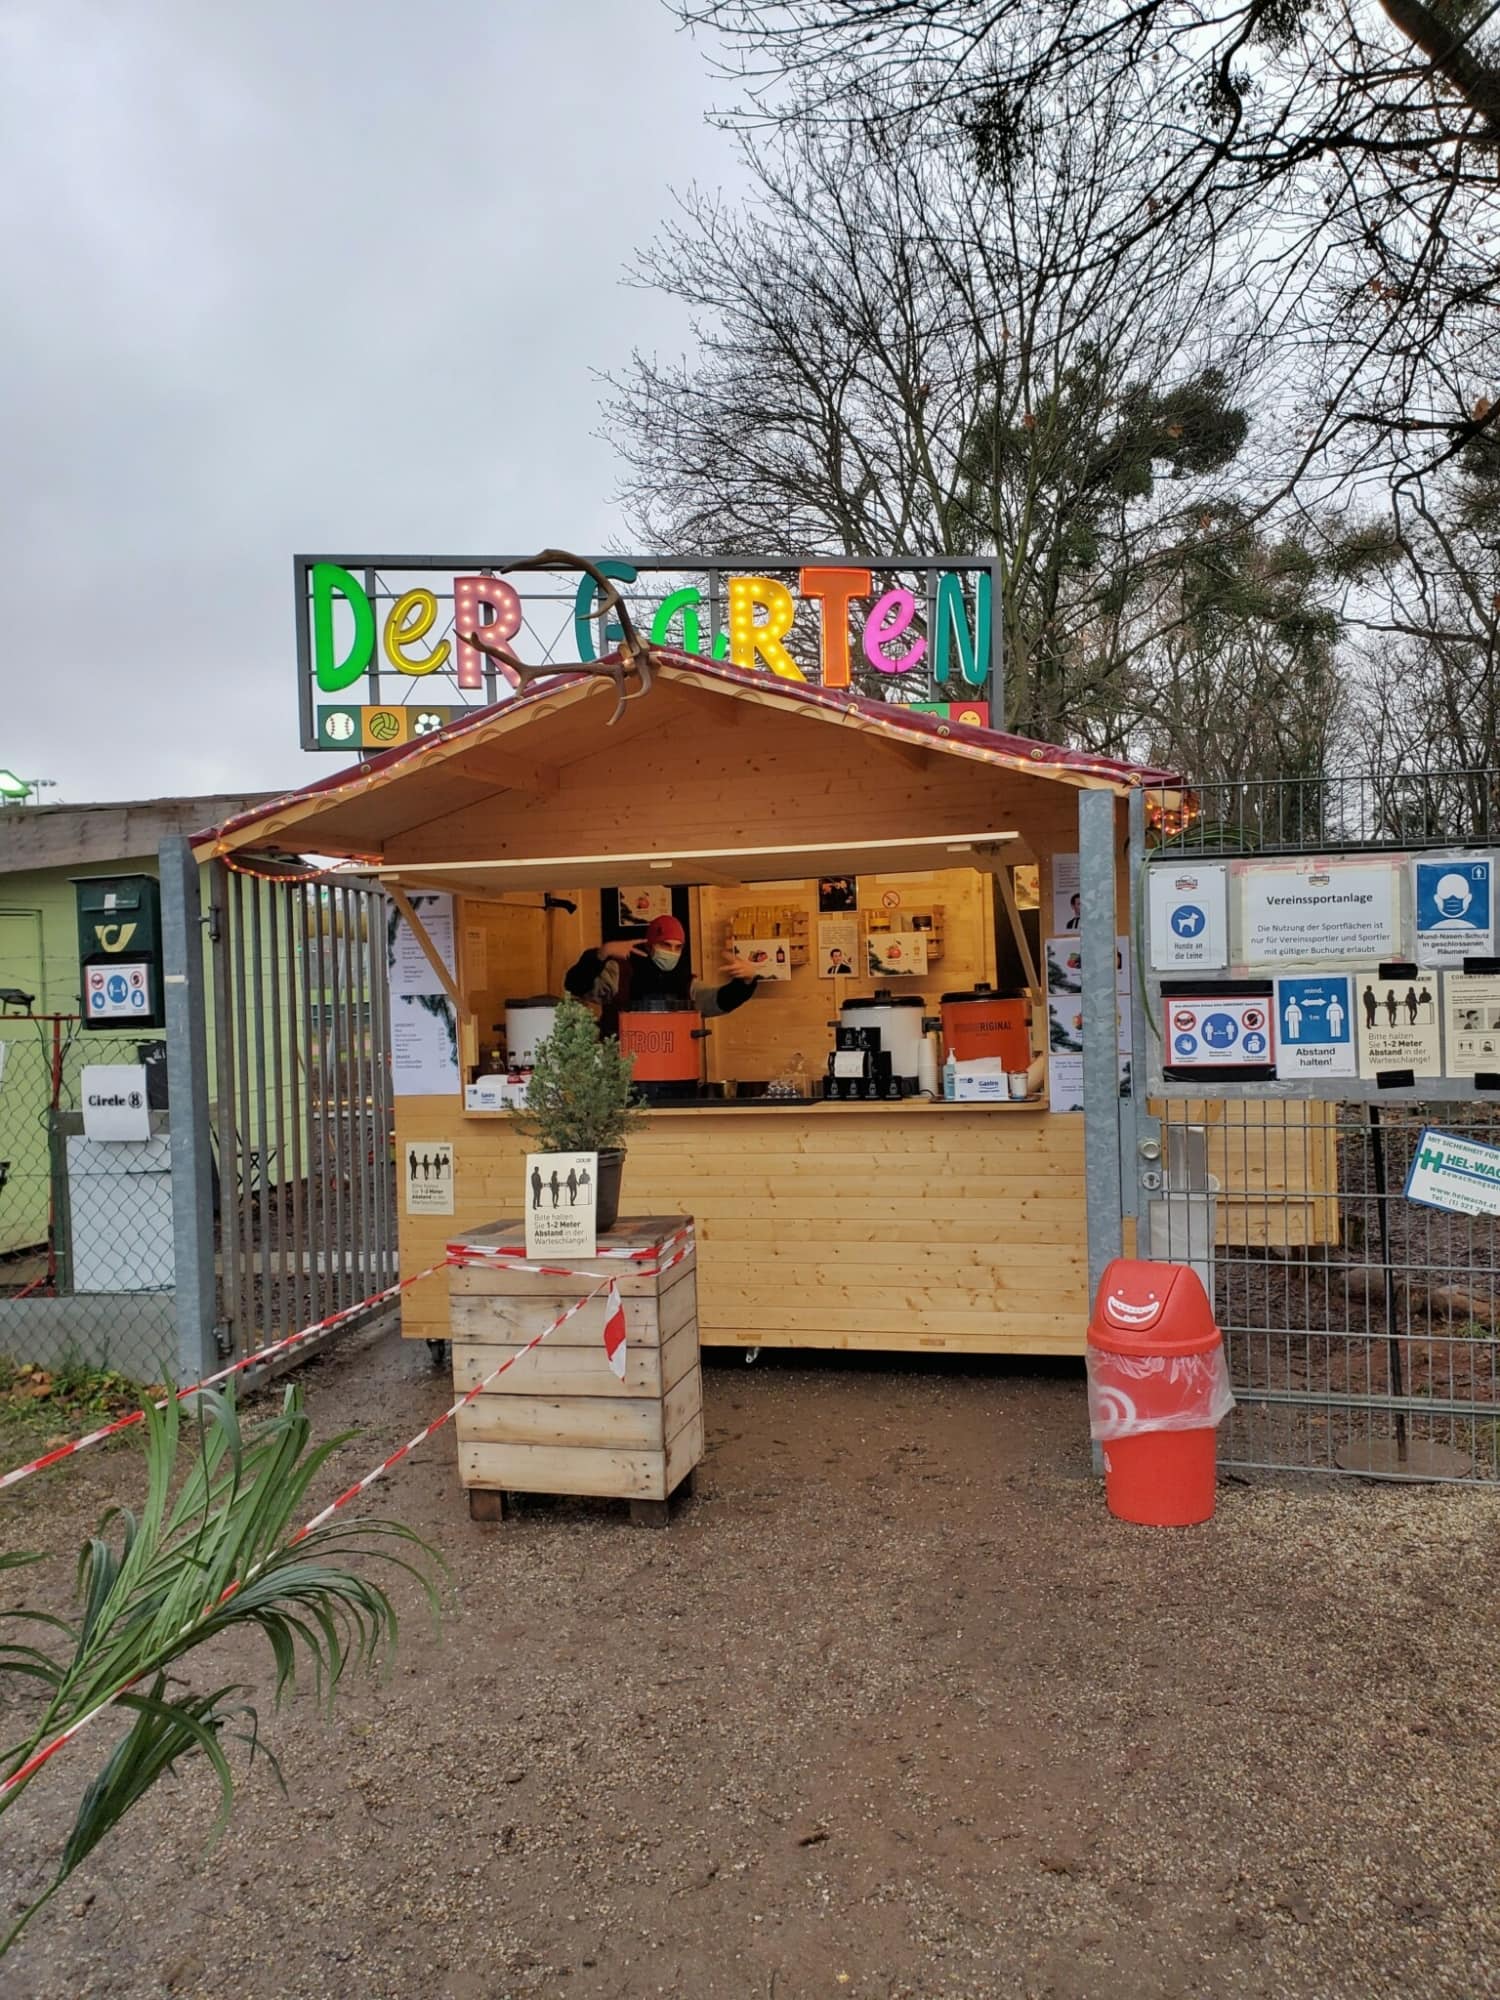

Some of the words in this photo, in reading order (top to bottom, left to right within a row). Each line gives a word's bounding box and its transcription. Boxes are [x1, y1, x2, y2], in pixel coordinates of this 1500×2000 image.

[1266, 893, 1374, 906] Vereinssportanlage
[1257, 925, 1271, 933] Die
[1272, 924, 1305, 933] Nutzung
[1306, 923, 1320, 931] der
[1321, 922, 1372, 933] Sportflächen
[1373, 922, 1384, 930] ist
[1266, 935, 1277, 944] für
[1279, 934, 1339, 945] Vereinssportler
[1341, 933, 1357, 942] und
[1358, 933, 1391, 944] Sportler
[1417, 932, 1489, 940] Mund-Nasen-Schutz
[1431, 941, 1484, 949] geschlossenen
[1264, 947, 1277, 955] mit
[1279, 946, 1309, 957] gültiger
[1311, 945, 1345, 956] Buchung
[1346, 945, 1376, 953] erlaubt
[1389, 1032, 1414, 1040] halten
[1296, 1047, 1336, 1056] Abstand
[1369, 1048, 1402, 1056] Abstand
[1414, 1047, 1426, 1055] der
[1300, 1057, 1333, 1067] halten!
[88, 1094, 126, 1106] Circle
[547, 1221, 558, 1229] 1-2
